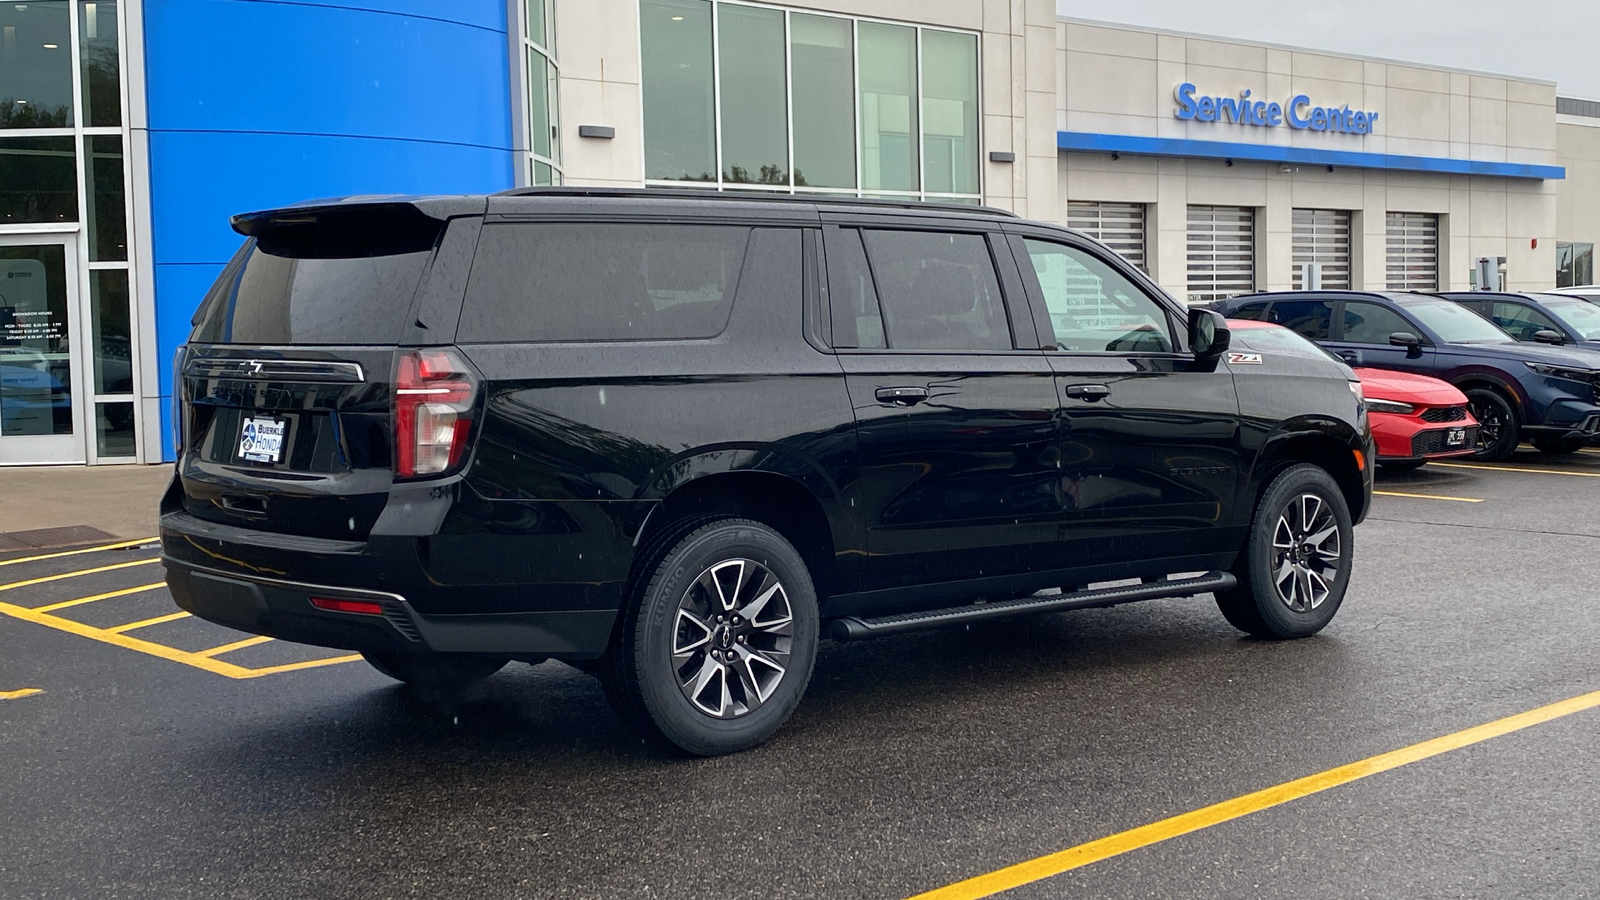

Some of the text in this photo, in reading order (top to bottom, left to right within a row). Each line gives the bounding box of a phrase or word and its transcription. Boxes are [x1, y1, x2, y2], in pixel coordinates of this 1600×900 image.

[1175, 82, 1379, 134] Service Center
[1227, 352, 1262, 364] Z71
[255, 434, 281, 451] HONDA
[653, 566, 685, 627] KUMHO
